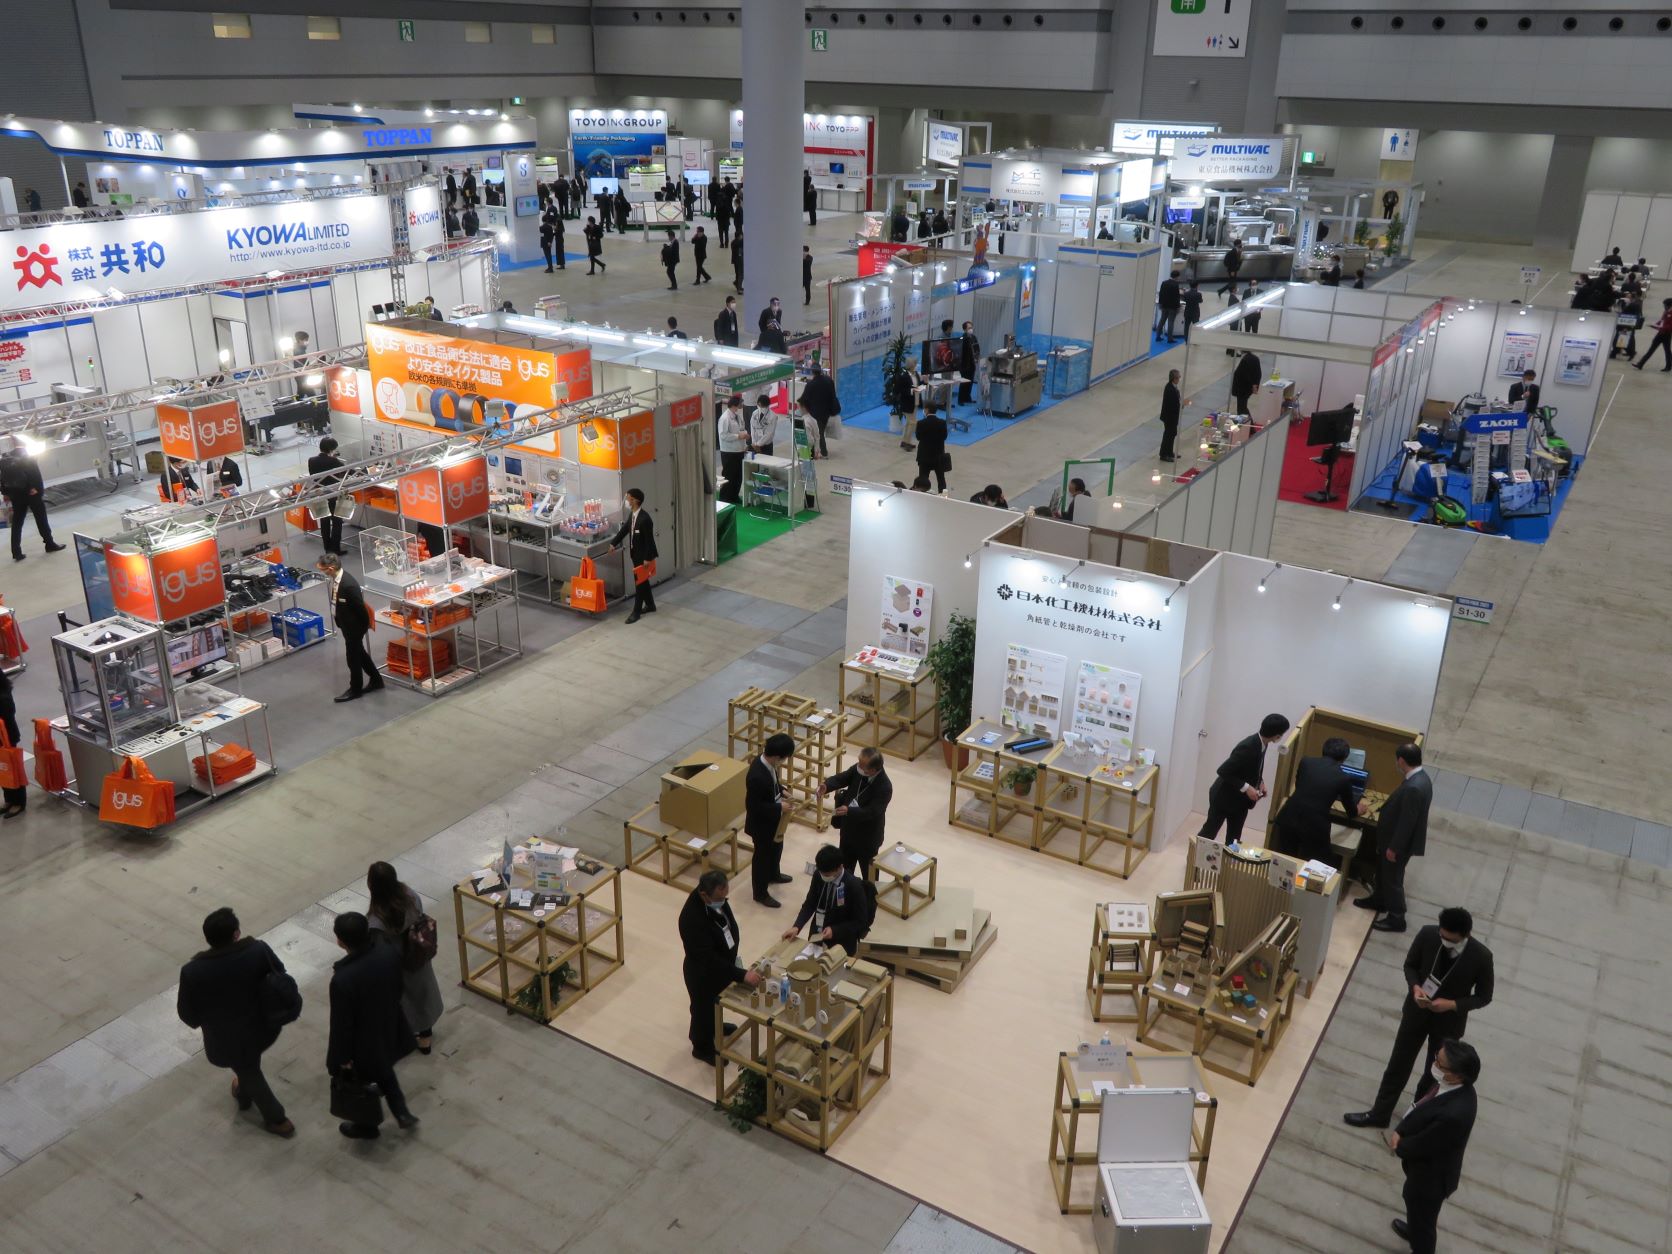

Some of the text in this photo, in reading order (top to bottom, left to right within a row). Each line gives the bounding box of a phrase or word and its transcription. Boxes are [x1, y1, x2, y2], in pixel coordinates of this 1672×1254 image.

[104, 129, 164, 151] TOPPAN
[363, 128, 432, 147] TOPPAN
[1211, 144, 1271, 155] MULTIVAC
[415, 210, 440, 226] KYOWA
[101, 240, 166, 278] 共和
[405, 342, 512, 372] 改正食品衛生法に適合
[517, 355, 550, 381] igus
[197, 417, 238, 446] igus
[1479, 418, 1519, 428] ZAOH
[446, 475, 485, 510] igus
[159, 560, 218, 603] igus
[575, 586, 593, 599] igus
[1016, 589, 1163, 632] 日本化工機材株式会社
[1457, 607, 1486, 619] S1-30
[1026, 613, 1128, 643] 角紙管と乾燥剤の会社です
[112, 789, 144, 810] igus
